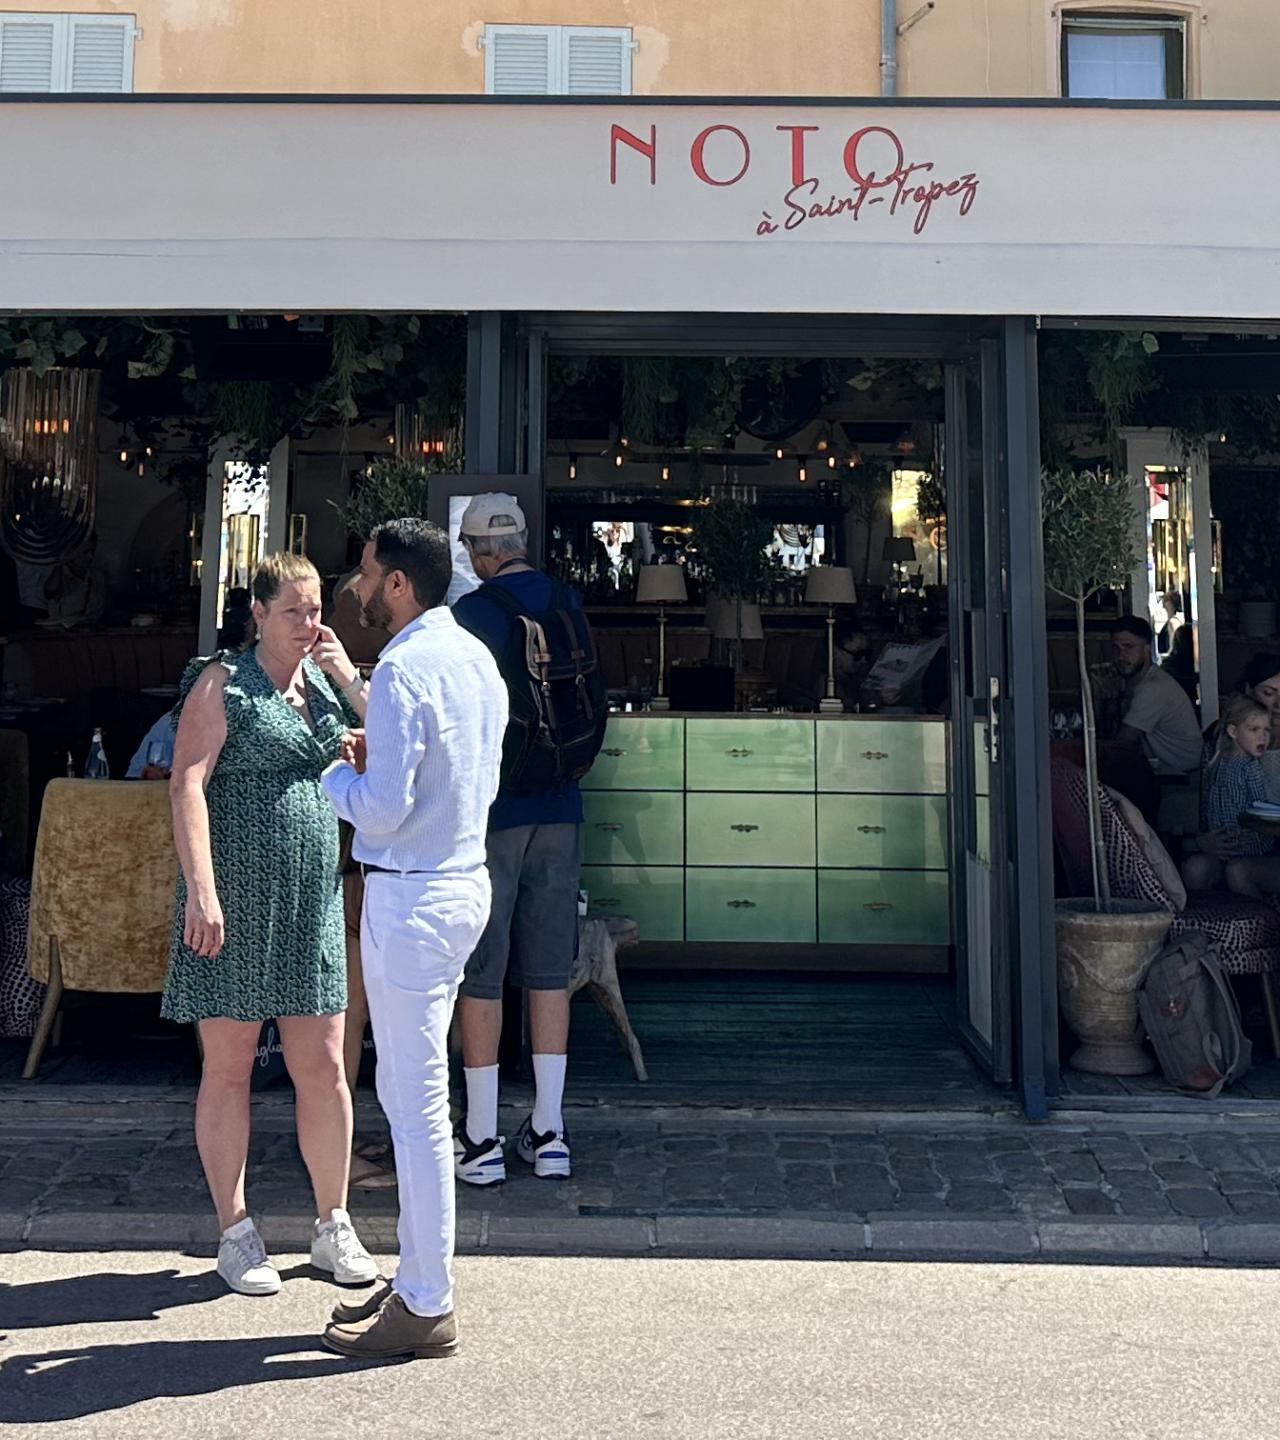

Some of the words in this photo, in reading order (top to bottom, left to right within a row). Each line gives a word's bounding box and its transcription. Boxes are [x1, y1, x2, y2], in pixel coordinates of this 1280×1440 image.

[610, 123, 904, 189] NOTO
[755, 211, 780, 236] à
[783, 162, 981, 235] Saint-Tropez
